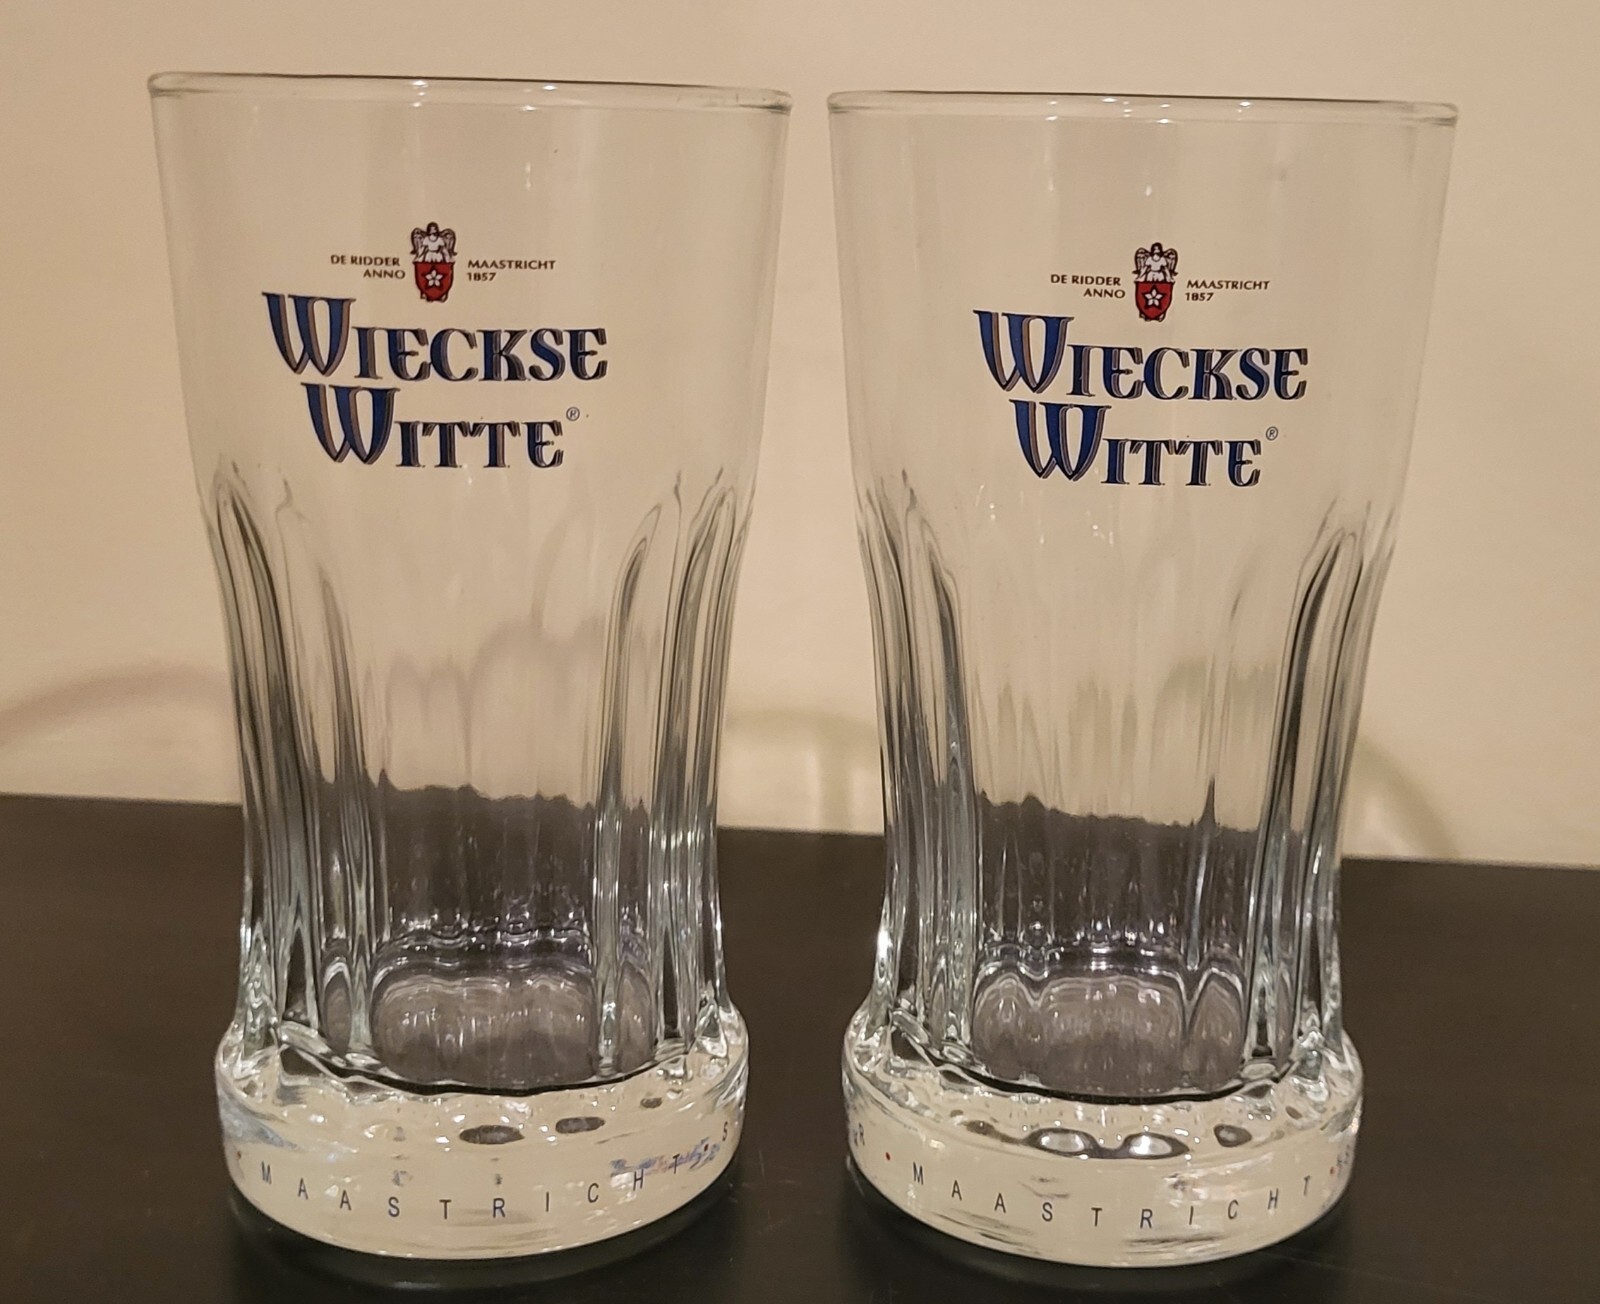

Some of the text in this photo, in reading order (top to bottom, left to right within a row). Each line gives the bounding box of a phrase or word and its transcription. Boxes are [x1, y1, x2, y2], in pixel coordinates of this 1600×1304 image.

[330, 254, 401, 267] DE RIDDER
[467, 259, 556, 271] MAASTRICHT
[363, 268, 406, 280] ANNO
[467, 272, 496, 282] 1857
[1050, 274, 1121, 286] DE RIDDER
[1186, 279, 1270, 291] MAASTRICHT
[1083, 287, 1126, 299] ANNO
[1185, 292, 1214, 302] 1857
[262, 292, 608, 382] WIECKSE
[973, 310, 1308, 401] WIECKSE
[301, 382, 563, 469] WITTE
[1009, 399, 1262, 487] WITTE
